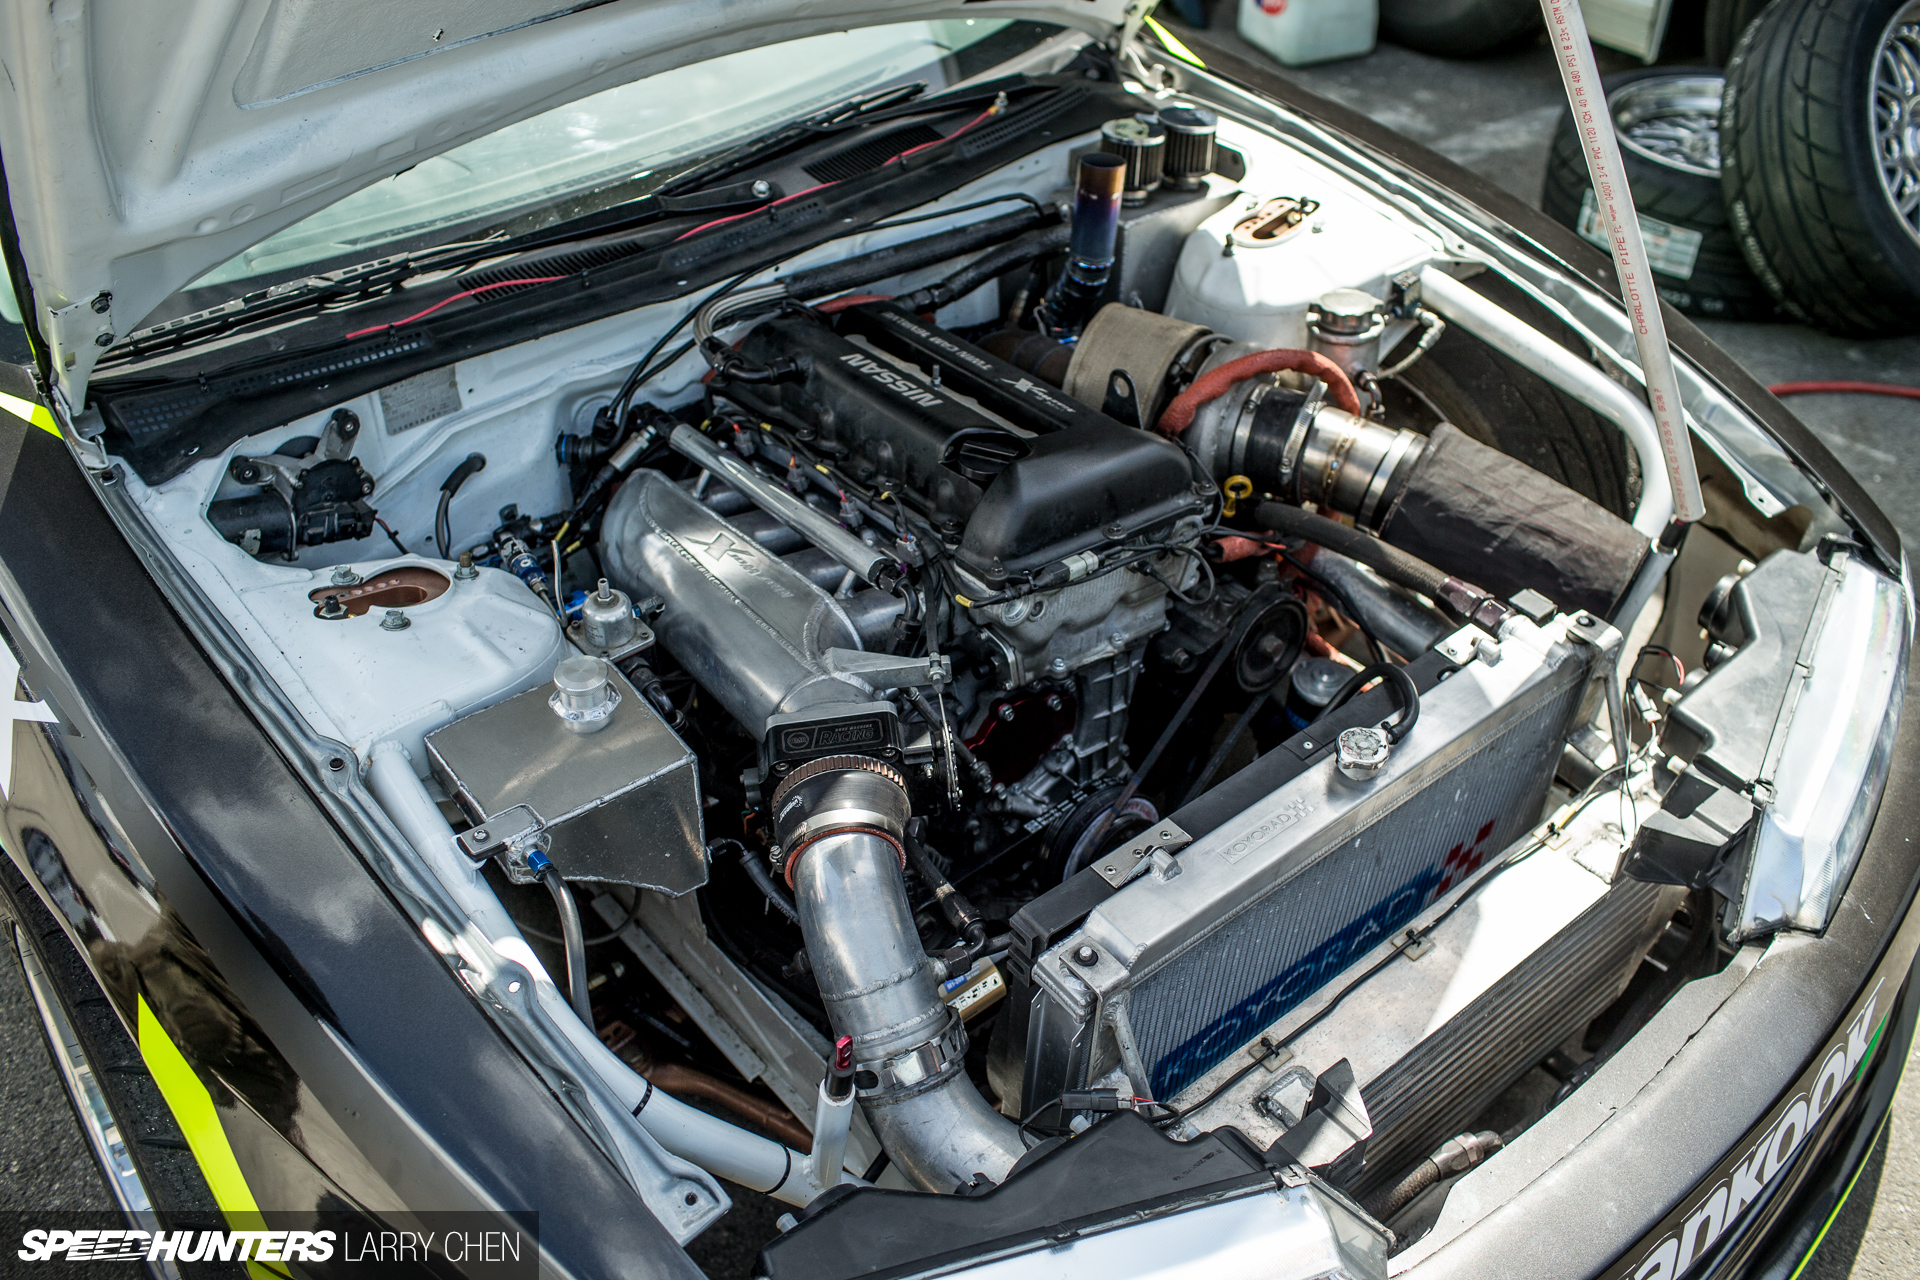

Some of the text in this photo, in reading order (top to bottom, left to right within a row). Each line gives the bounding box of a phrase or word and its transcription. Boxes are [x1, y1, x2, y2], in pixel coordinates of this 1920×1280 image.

[1552, 6, 1566, 25] ASTM
[1566, 54, 1577, 68] PSI
[1570, 70, 1582, 84] 480
[1575, 86, 1585, 97] PR
[1578, 98, 1588, 108] 40
[1582, 110, 1593, 124] SCH
[1586, 127, 1598, 144] 1120
[1592, 146, 1603, 160] PVC
[1616, 236, 1631, 266] PIPE
[1625, 272, 1648, 335] CHARLOTTE
[929, 335, 960, 353] CAM
[955, 351, 994, 371] TWIN
[840, 353, 943, 408] NISSAN
[820, 728, 874, 746] RACING
[1223, 813, 1292, 859] KOYORAD
